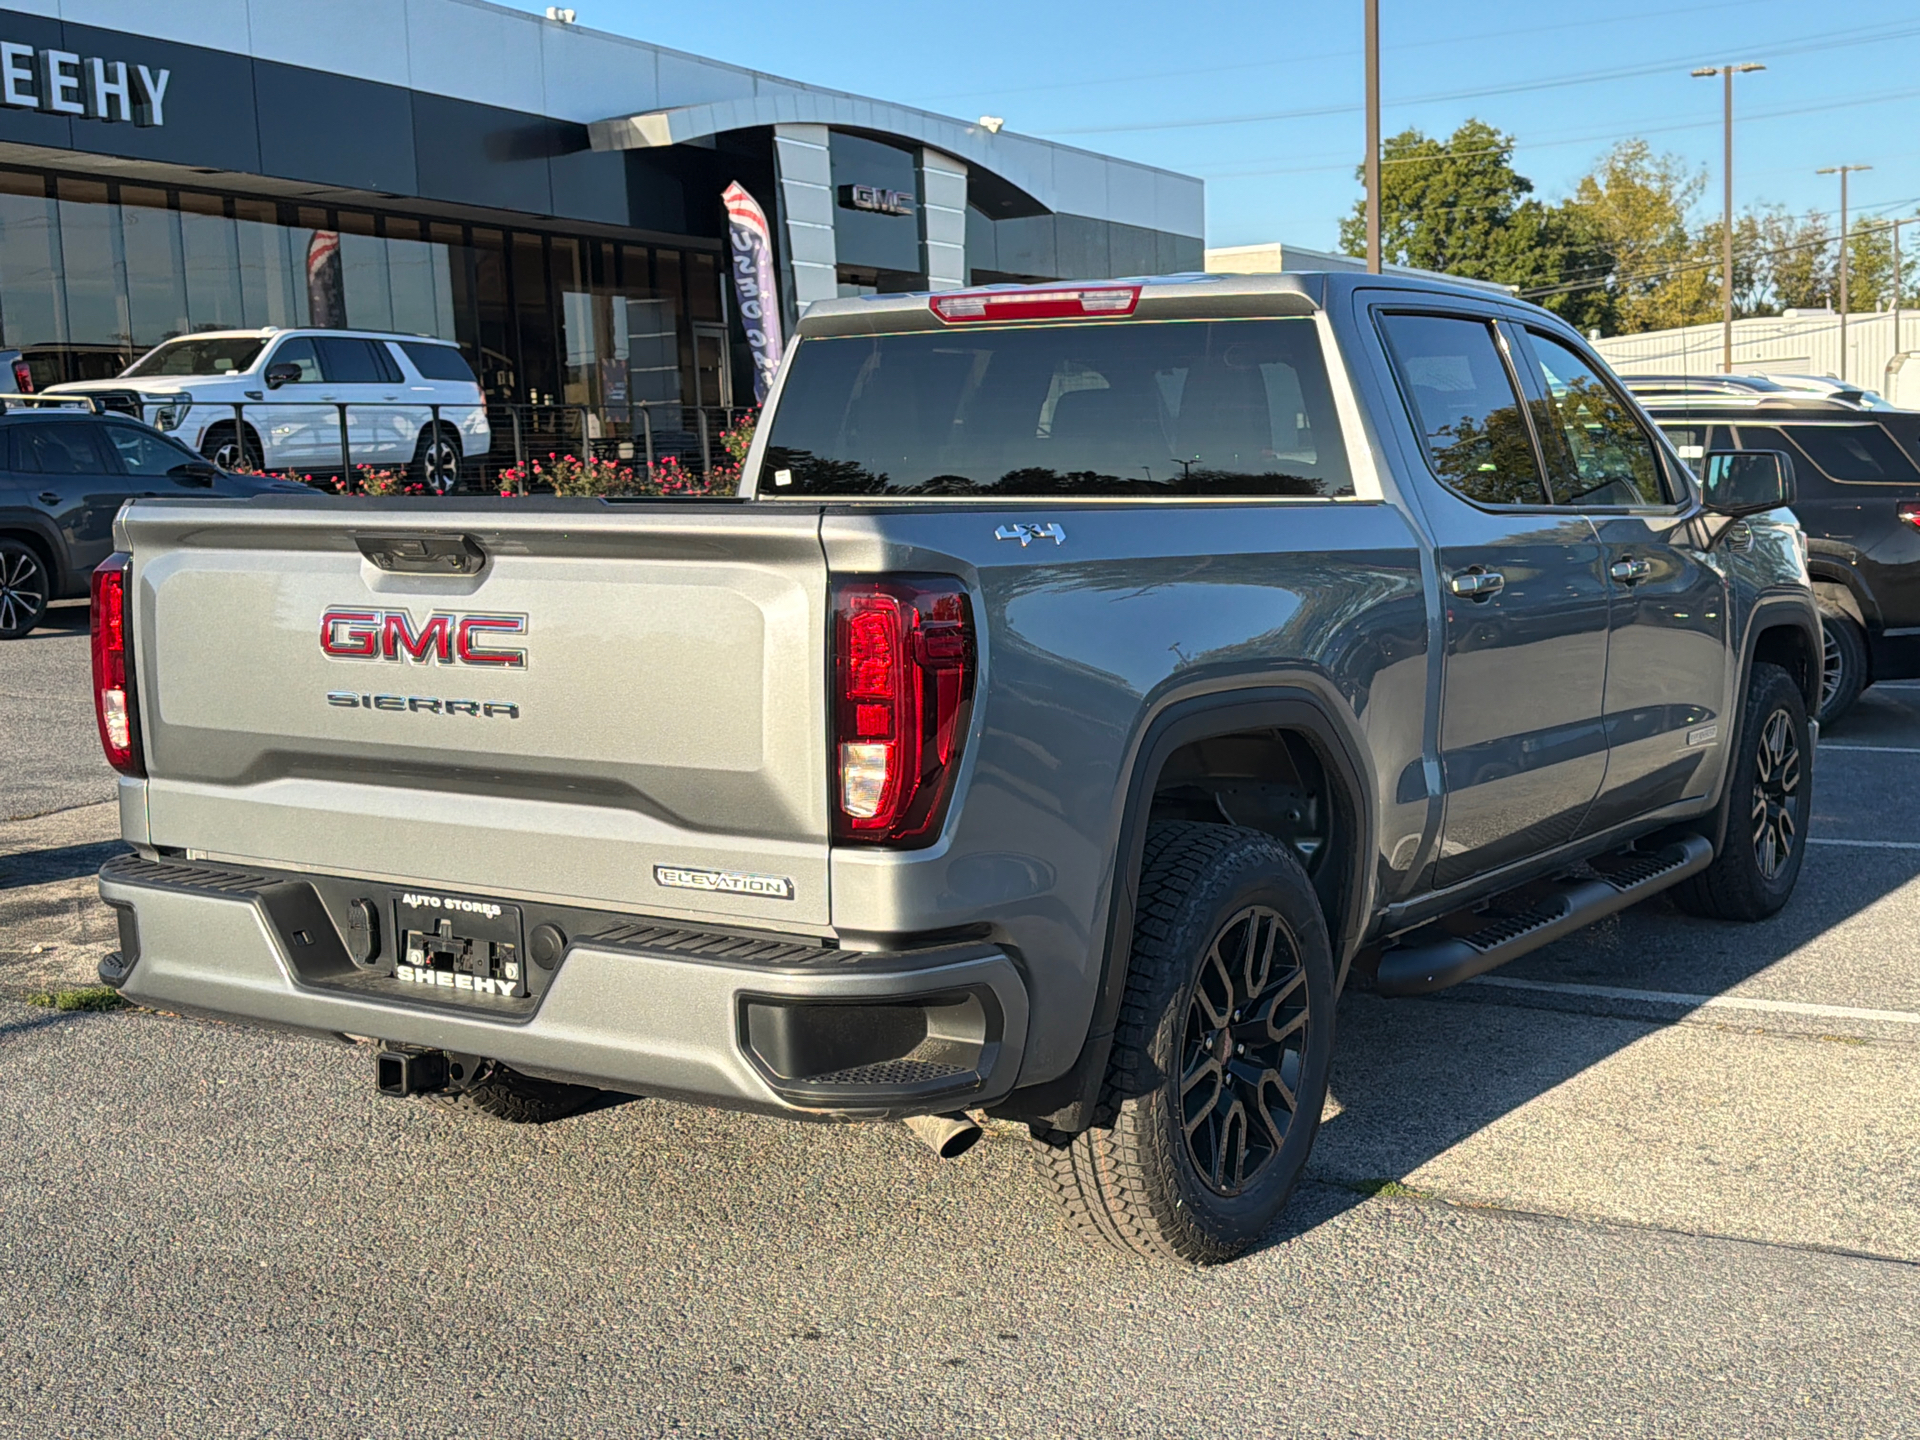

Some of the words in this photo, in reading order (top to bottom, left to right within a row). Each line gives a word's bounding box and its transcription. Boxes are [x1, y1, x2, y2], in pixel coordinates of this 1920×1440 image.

[0, 41, 170, 126] EEHY
[851, 183, 914, 216] GMC
[320, 604, 528, 670] GMC
[327, 690, 520, 719] SIERRA
[663, 871, 781, 893] ELEVATION
[402, 893, 442, 908] AUTO
[444, 898, 501, 916] STORES
[397, 965, 517, 996] SHEEHY
